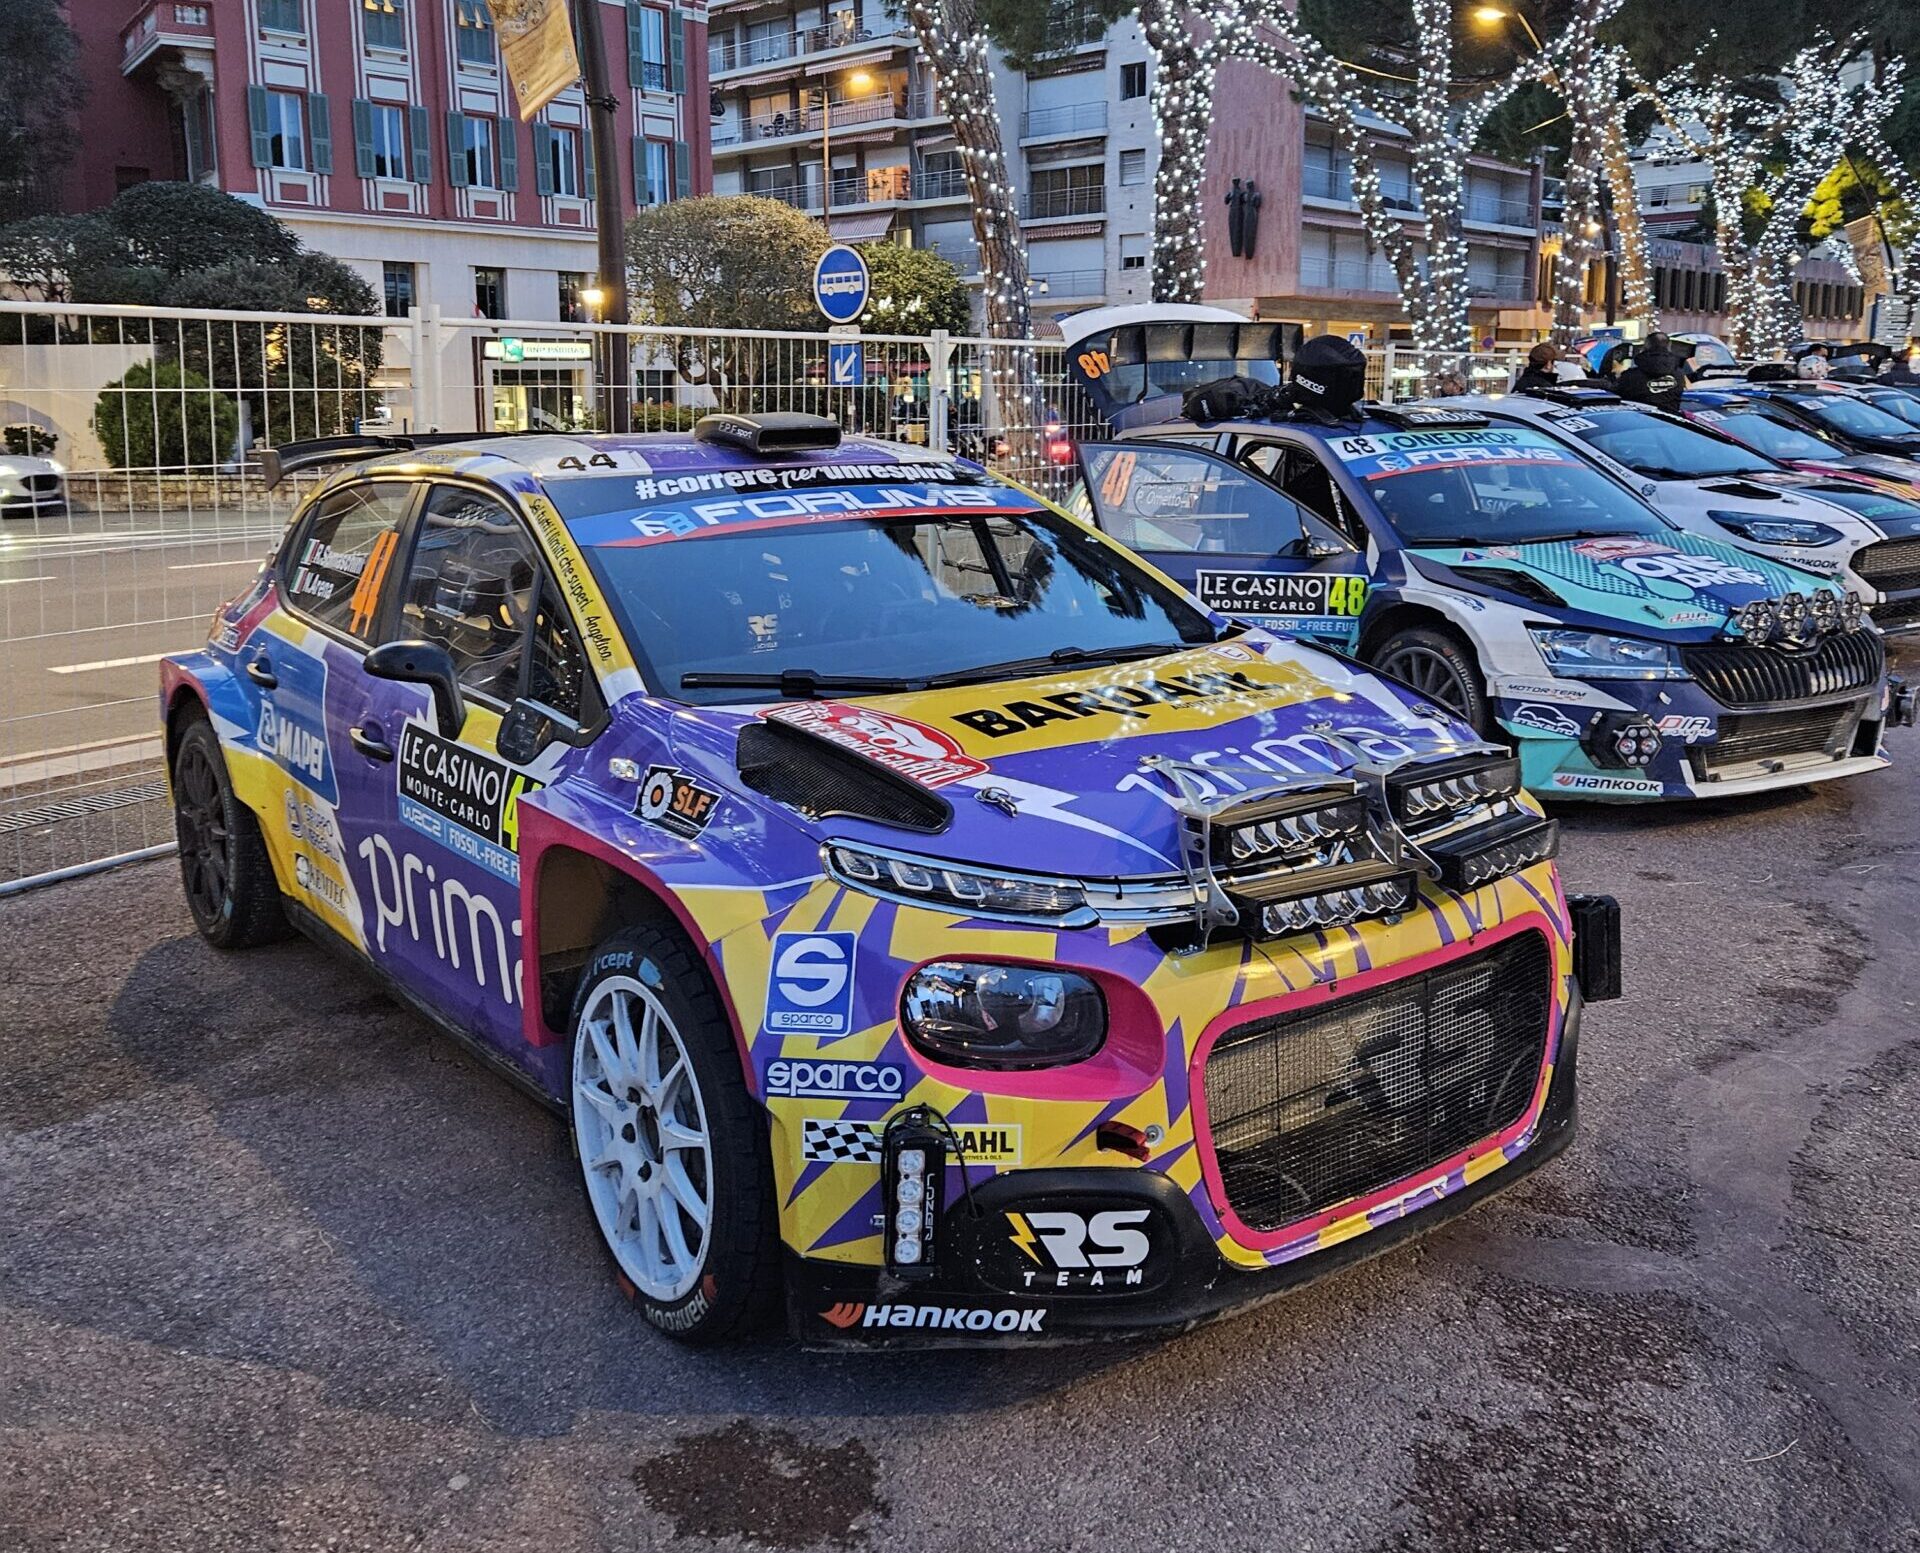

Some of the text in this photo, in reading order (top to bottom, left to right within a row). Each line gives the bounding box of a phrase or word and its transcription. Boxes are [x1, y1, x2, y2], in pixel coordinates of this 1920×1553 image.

[1077, 350, 1112, 379] 48
[556, 453, 618, 472] 44
[1342, 437, 1375, 456] 48
[1101, 451, 1137, 507] 48
[692, 488, 998, 526] FORUM8
[558, 555, 575, 578] che
[1621, 554, 1729, 578] ONE
[1203, 575, 1323, 598] LE CASINO
[1328, 576, 1367, 616] 48
[1265, 619, 1334, 632] FOSSIL-FREE
[950, 670, 1287, 738] BARDAHL
[277, 716, 325, 782] MAPEI
[402, 732, 501, 806] LE CASINO
[672, 784, 712, 819] SLF
[449, 827, 514, 877] FOSSIL-FREE
[780, 1012, 835, 1027] sparco
[766, 1060, 903, 1098] sparco
[1025, 1209, 1151, 1268] RS
